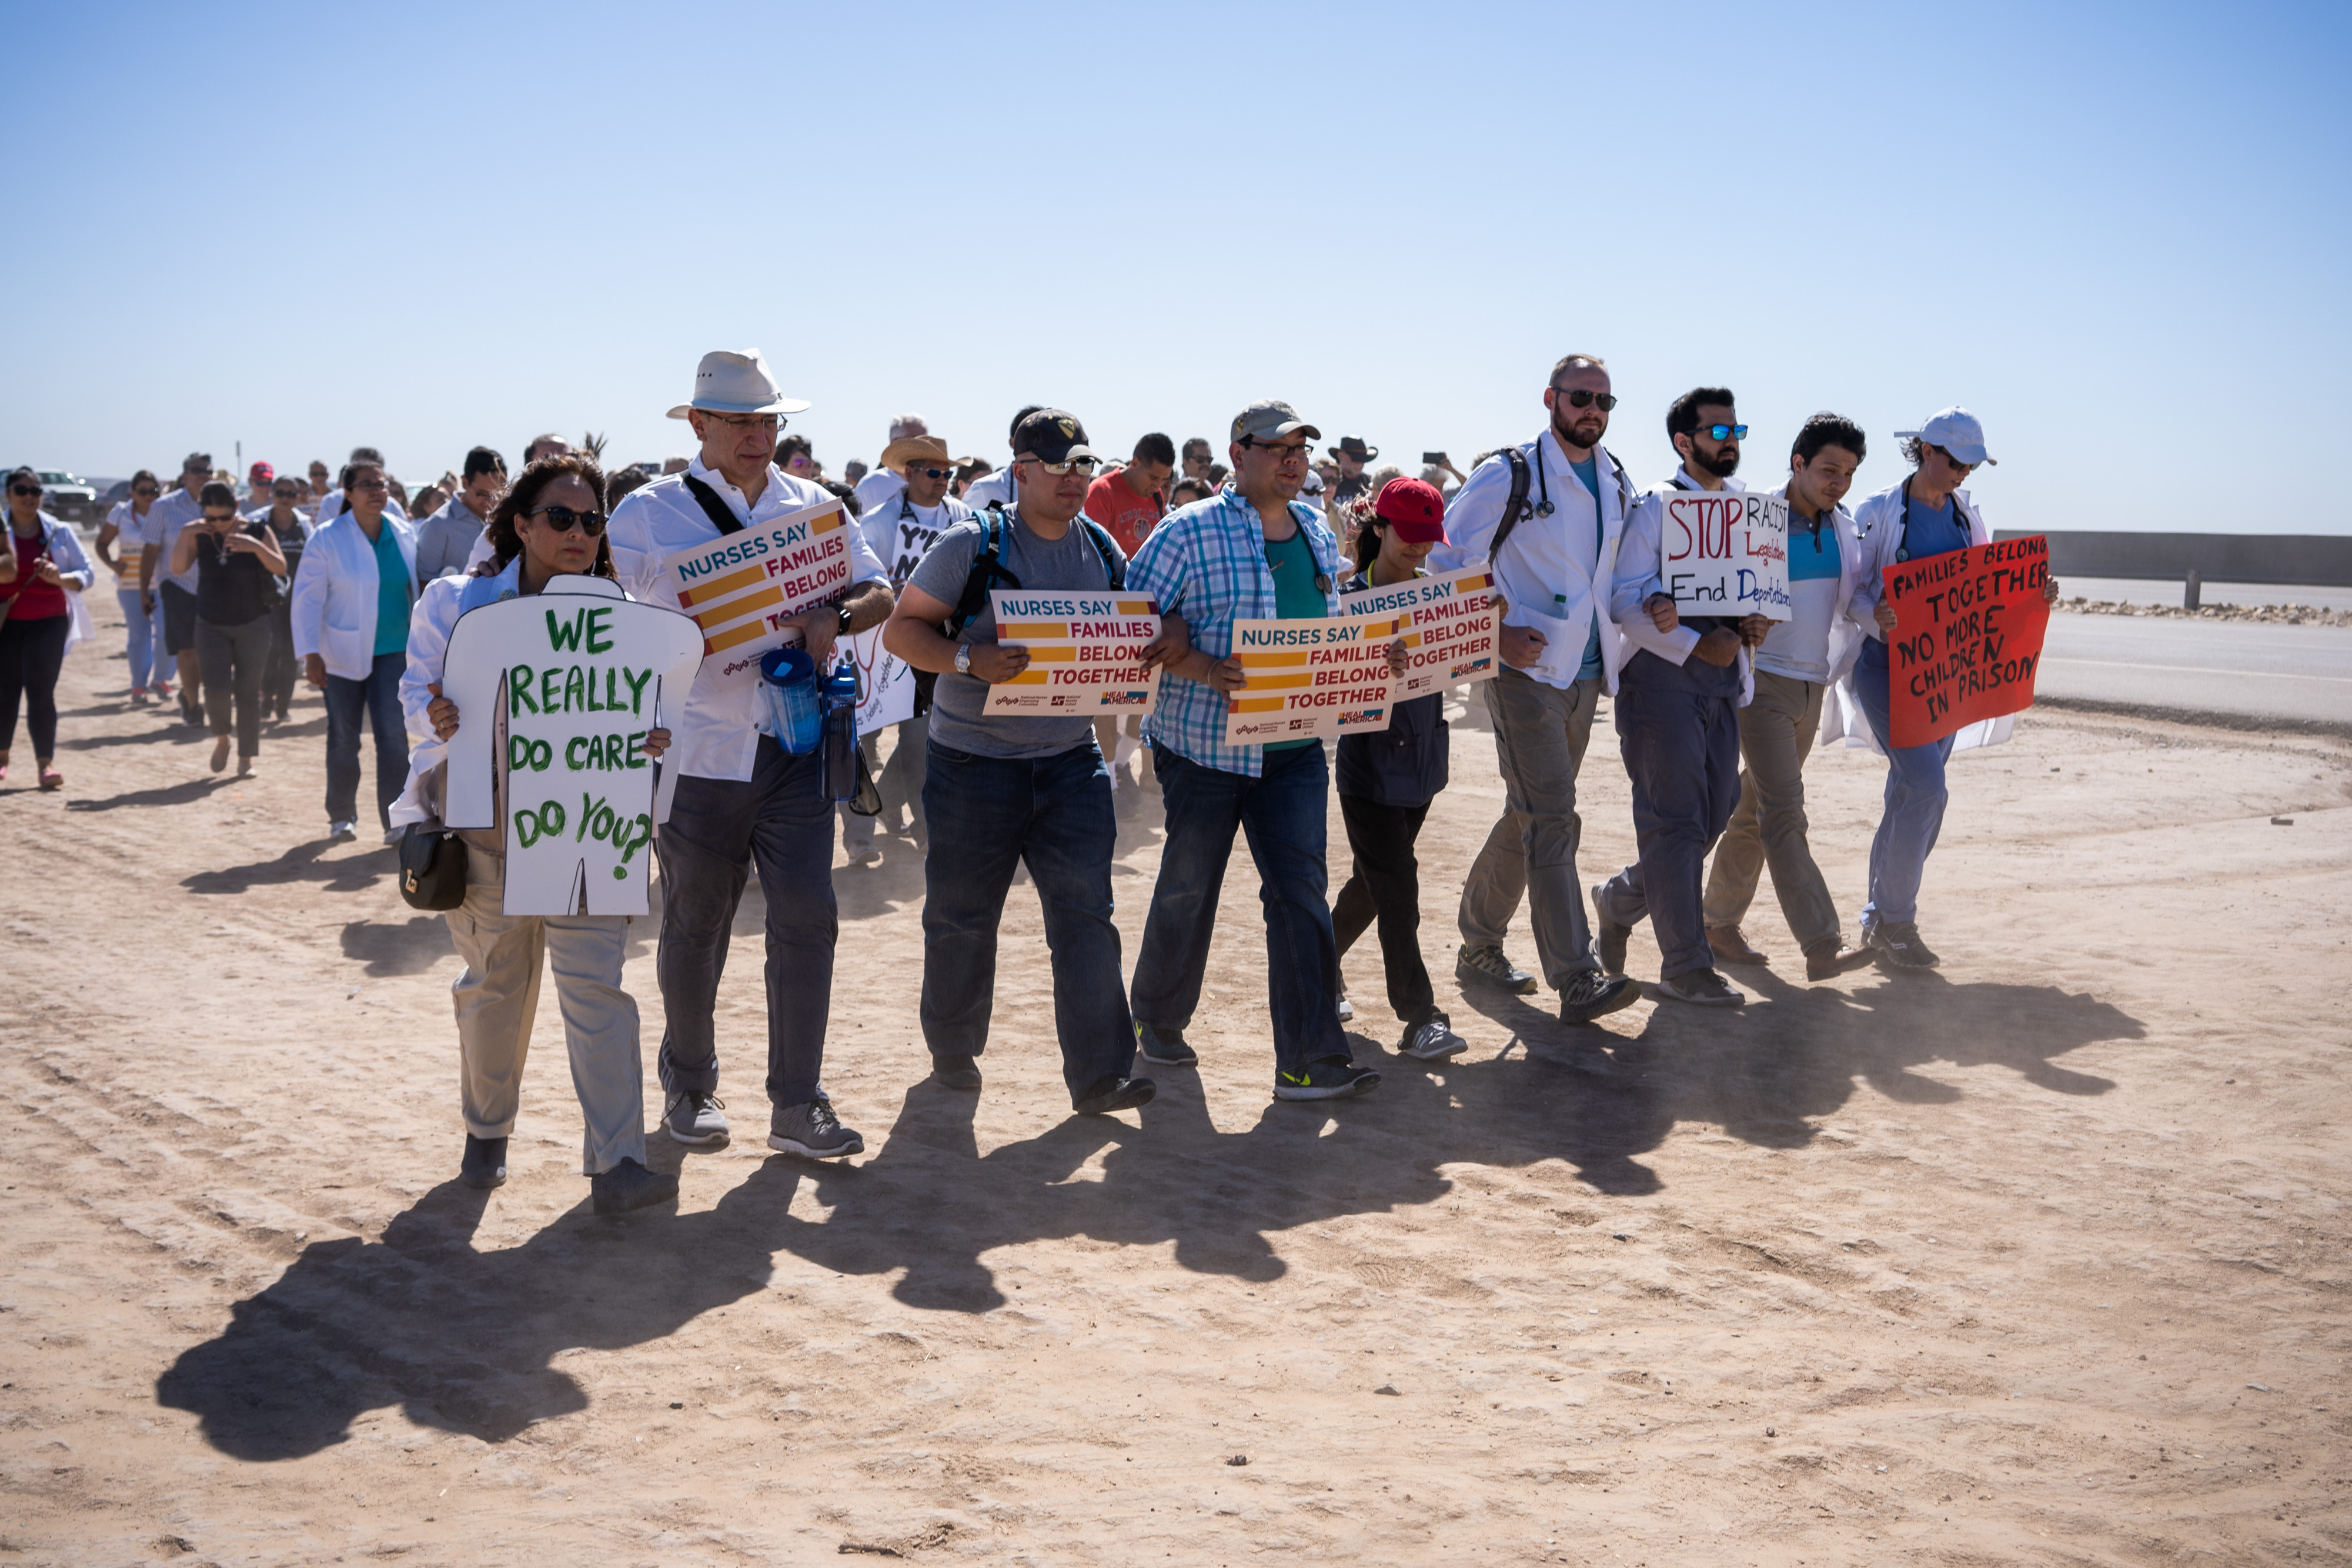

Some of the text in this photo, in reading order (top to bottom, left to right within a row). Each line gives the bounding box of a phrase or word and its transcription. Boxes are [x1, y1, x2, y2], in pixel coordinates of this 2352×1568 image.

[1668, 497, 1787, 561] STOP RACIST
[678, 521, 806, 582] NURSES SAY
[766, 536, 844, 577] FAMILIES
[784, 560, 846, 599] BELONG
[1893, 538, 2046, 599] FAMILIES BELONG
[1350, 581, 1451, 615] NURSES SAY
[1671, 573, 1727, 601] End
[1926, 560, 2048, 623] TOGETHER
[1001, 600, 1112, 616] NURSES SAY
[1413, 595, 1489, 626] FAMILIES
[546, 607, 614, 655] WE
[1071, 622, 1154, 638] FAMILIES
[1242, 626, 1361, 646] NURSES SAY
[1424, 616, 1491, 645] BELONG
[1897, 605, 2004, 669] NO MORE
[1079, 645, 1152, 661] BELON
[1309, 643, 1391, 665] FAMILIES
[1406, 637, 1491, 670] TOGETHER
[1454, 662, 1473, 672] HEAL
[1910, 634, 2004, 697] CHILDREN
[1052, 667, 1151, 684] TOGETHER
[1315, 665, 1389, 686] BELONG
[1456, 664, 1487, 677] AMERICA
[510, 664, 653, 720] REALLY
[1288, 687, 1387, 710] TOGETHER
[1927, 651, 2038, 724] IN PRISON
[1342, 710, 1364, 718] HEAL
[1343, 714, 1378, 724] AMERICA
[509, 730, 651, 773] DO CARE
[513, 792, 652, 880] DO YOU?
